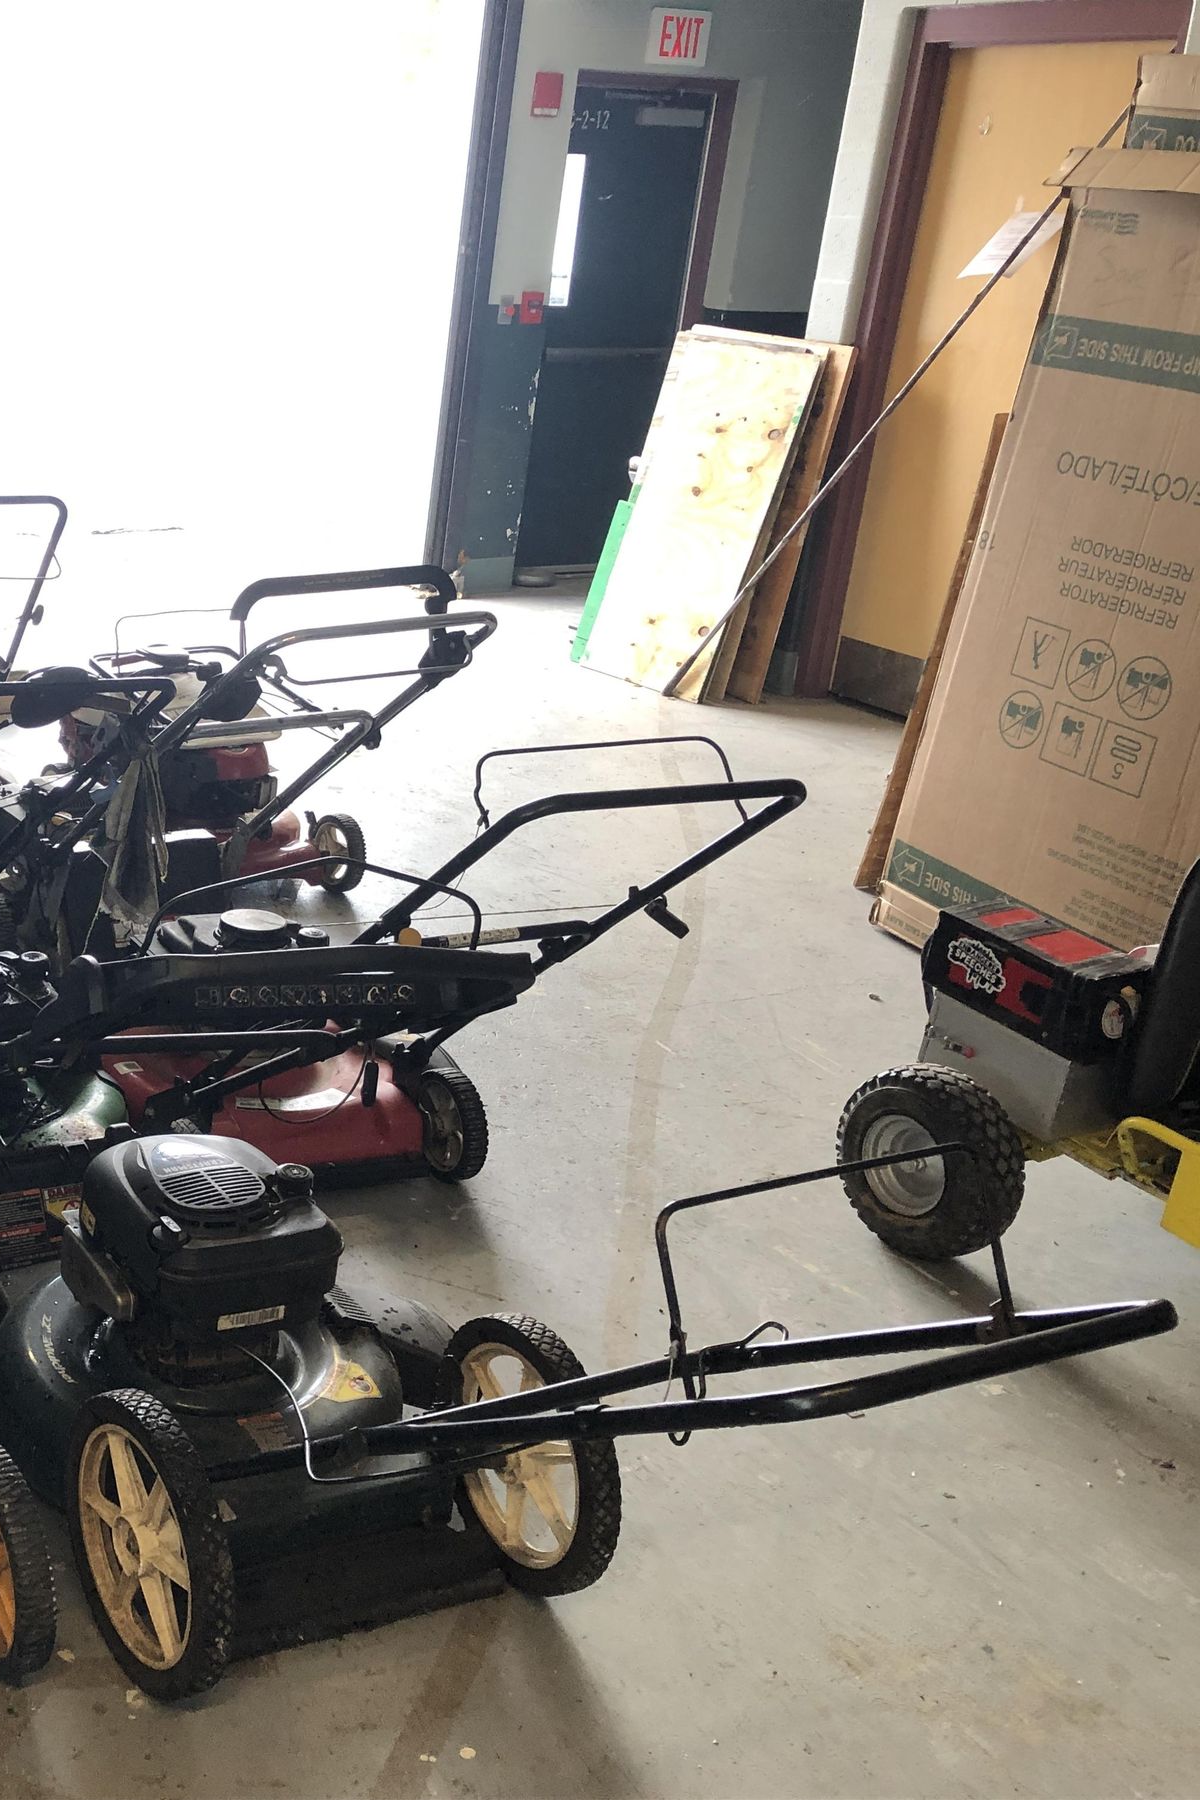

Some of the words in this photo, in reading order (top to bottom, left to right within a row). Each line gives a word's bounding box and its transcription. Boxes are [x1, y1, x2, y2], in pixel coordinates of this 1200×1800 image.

[658, 15, 704, 59] EXIT
[1077, 339, 1110, 361] SIDE
[1111, 342, 1140, 366] THIS
[1142, 349, 1182, 372] FROM
[979, 530, 996, 552] 18
[1071, 536, 1195, 583] REFRIGERADOR
[1058, 556, 1187, 607] RÉFRIGÉRATEUR
[1059, 581, 1179, 630] REFRIGERATOR
[1111, 762, 1125, 780] 5
[925, 871, 951, 898] SIDE
[950, 885, 977, 905] HIS
[954, 948, 997, 984] SPEECHES
[162, 1158, 227, 1174] CRAFTSMAN
